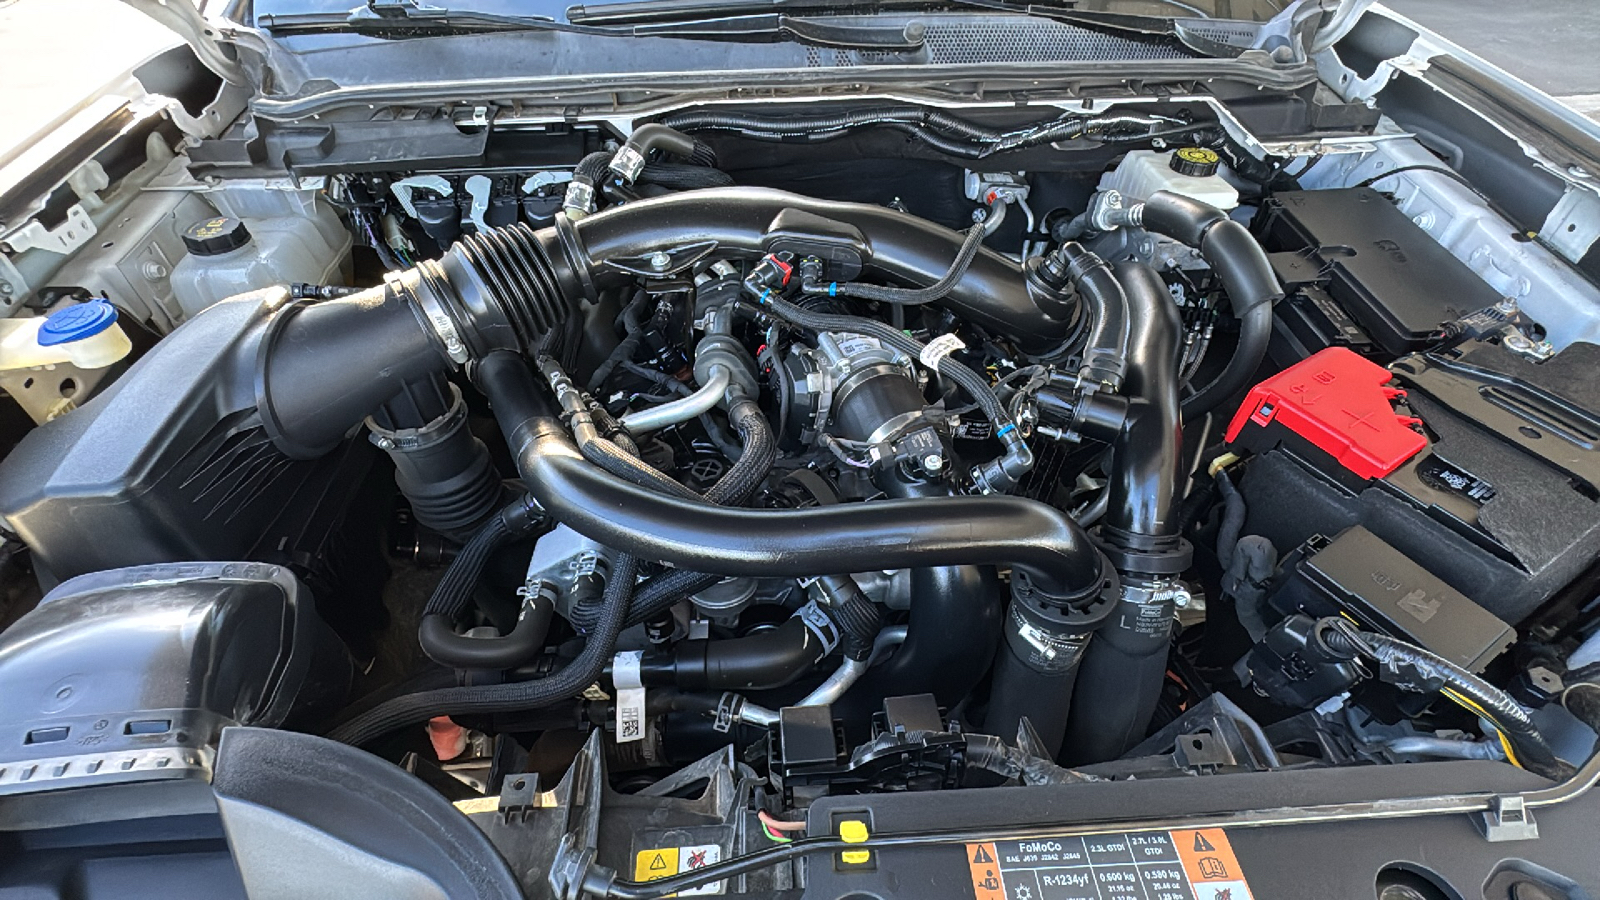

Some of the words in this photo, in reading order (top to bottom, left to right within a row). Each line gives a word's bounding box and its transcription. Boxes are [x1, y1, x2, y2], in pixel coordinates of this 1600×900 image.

[1019, 842, 1062, 852] FoMoCo
[1043, 873, 1089, 887] R-1234yf
[1099, 873, 1122, 882] 0.600
[1123, 872, 1135, 883] kg
[1168, 869, 1180, 880] kg
